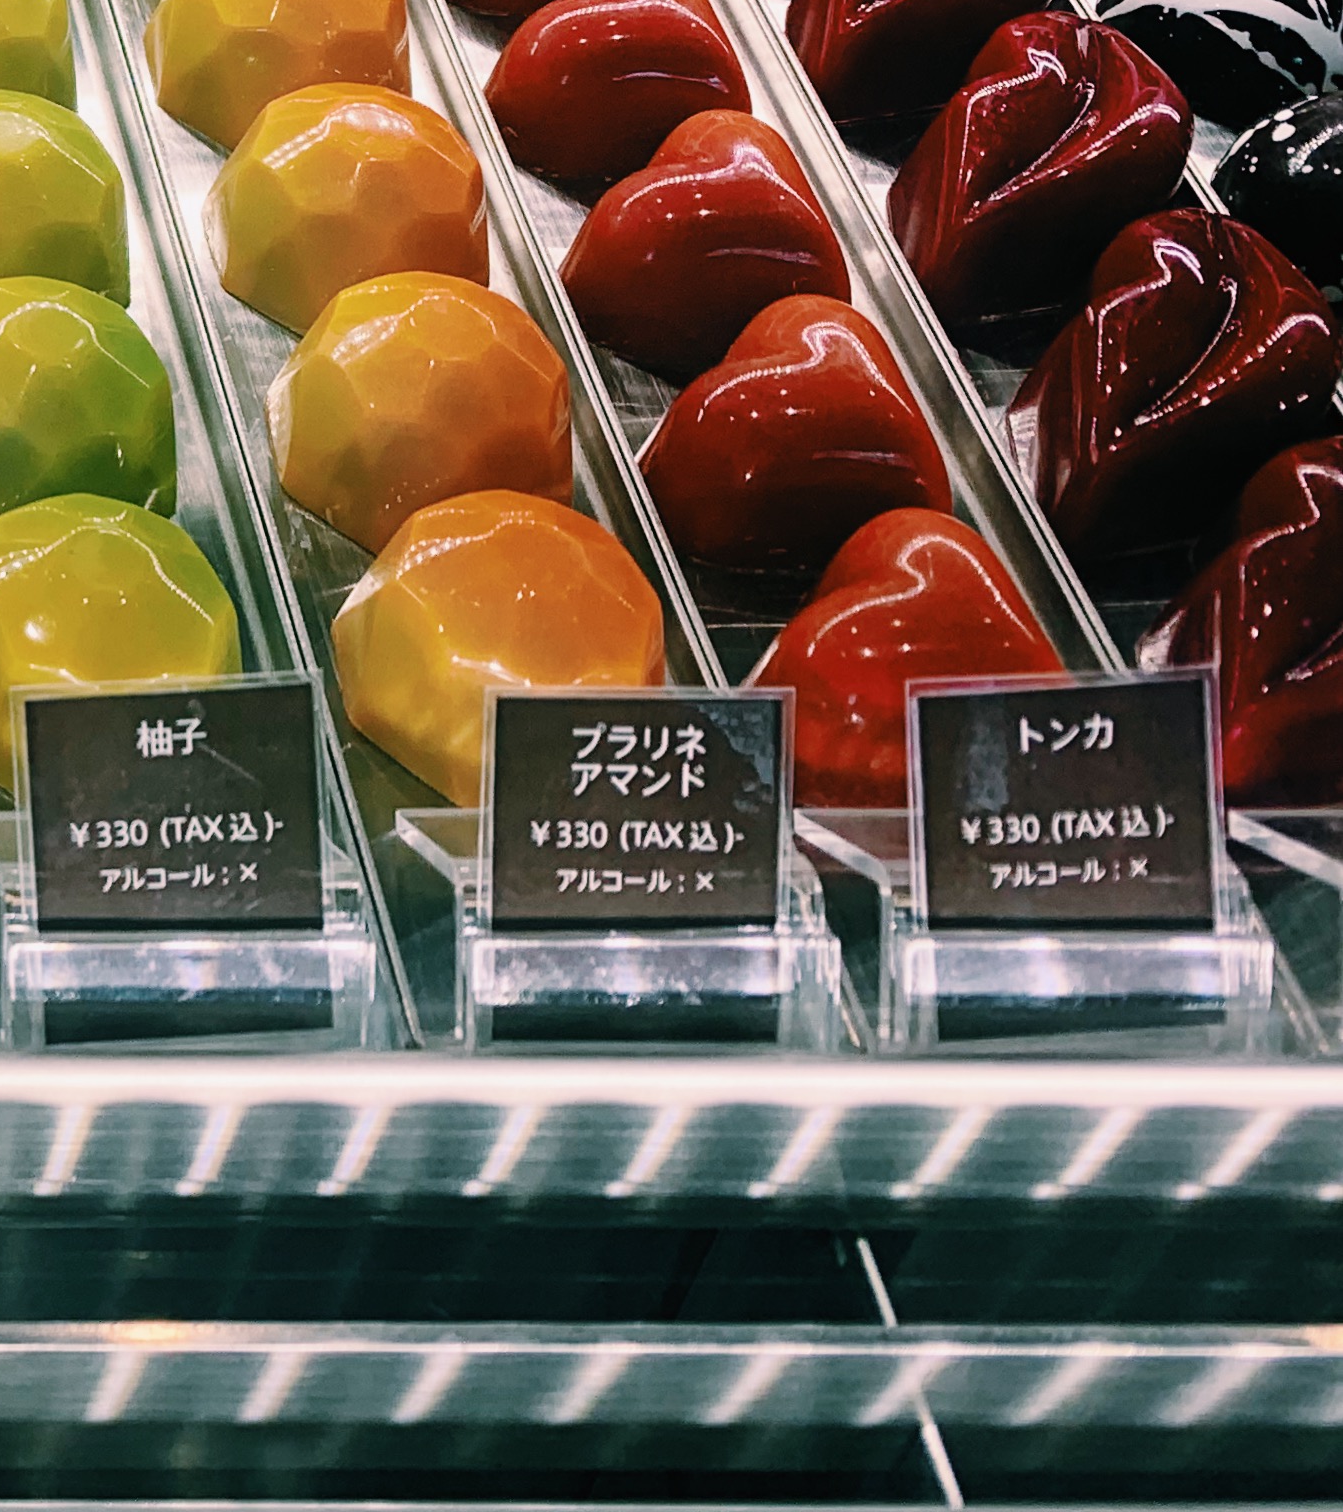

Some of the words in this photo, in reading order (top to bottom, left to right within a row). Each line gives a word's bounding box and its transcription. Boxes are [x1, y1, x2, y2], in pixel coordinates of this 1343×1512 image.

[137, 720, 206, 759] 柚子
[572, 725, 706, 760] プラリネ
[1018, 713, 1114, 755] トンカ
[572, 762, 706, 798] アマンド
